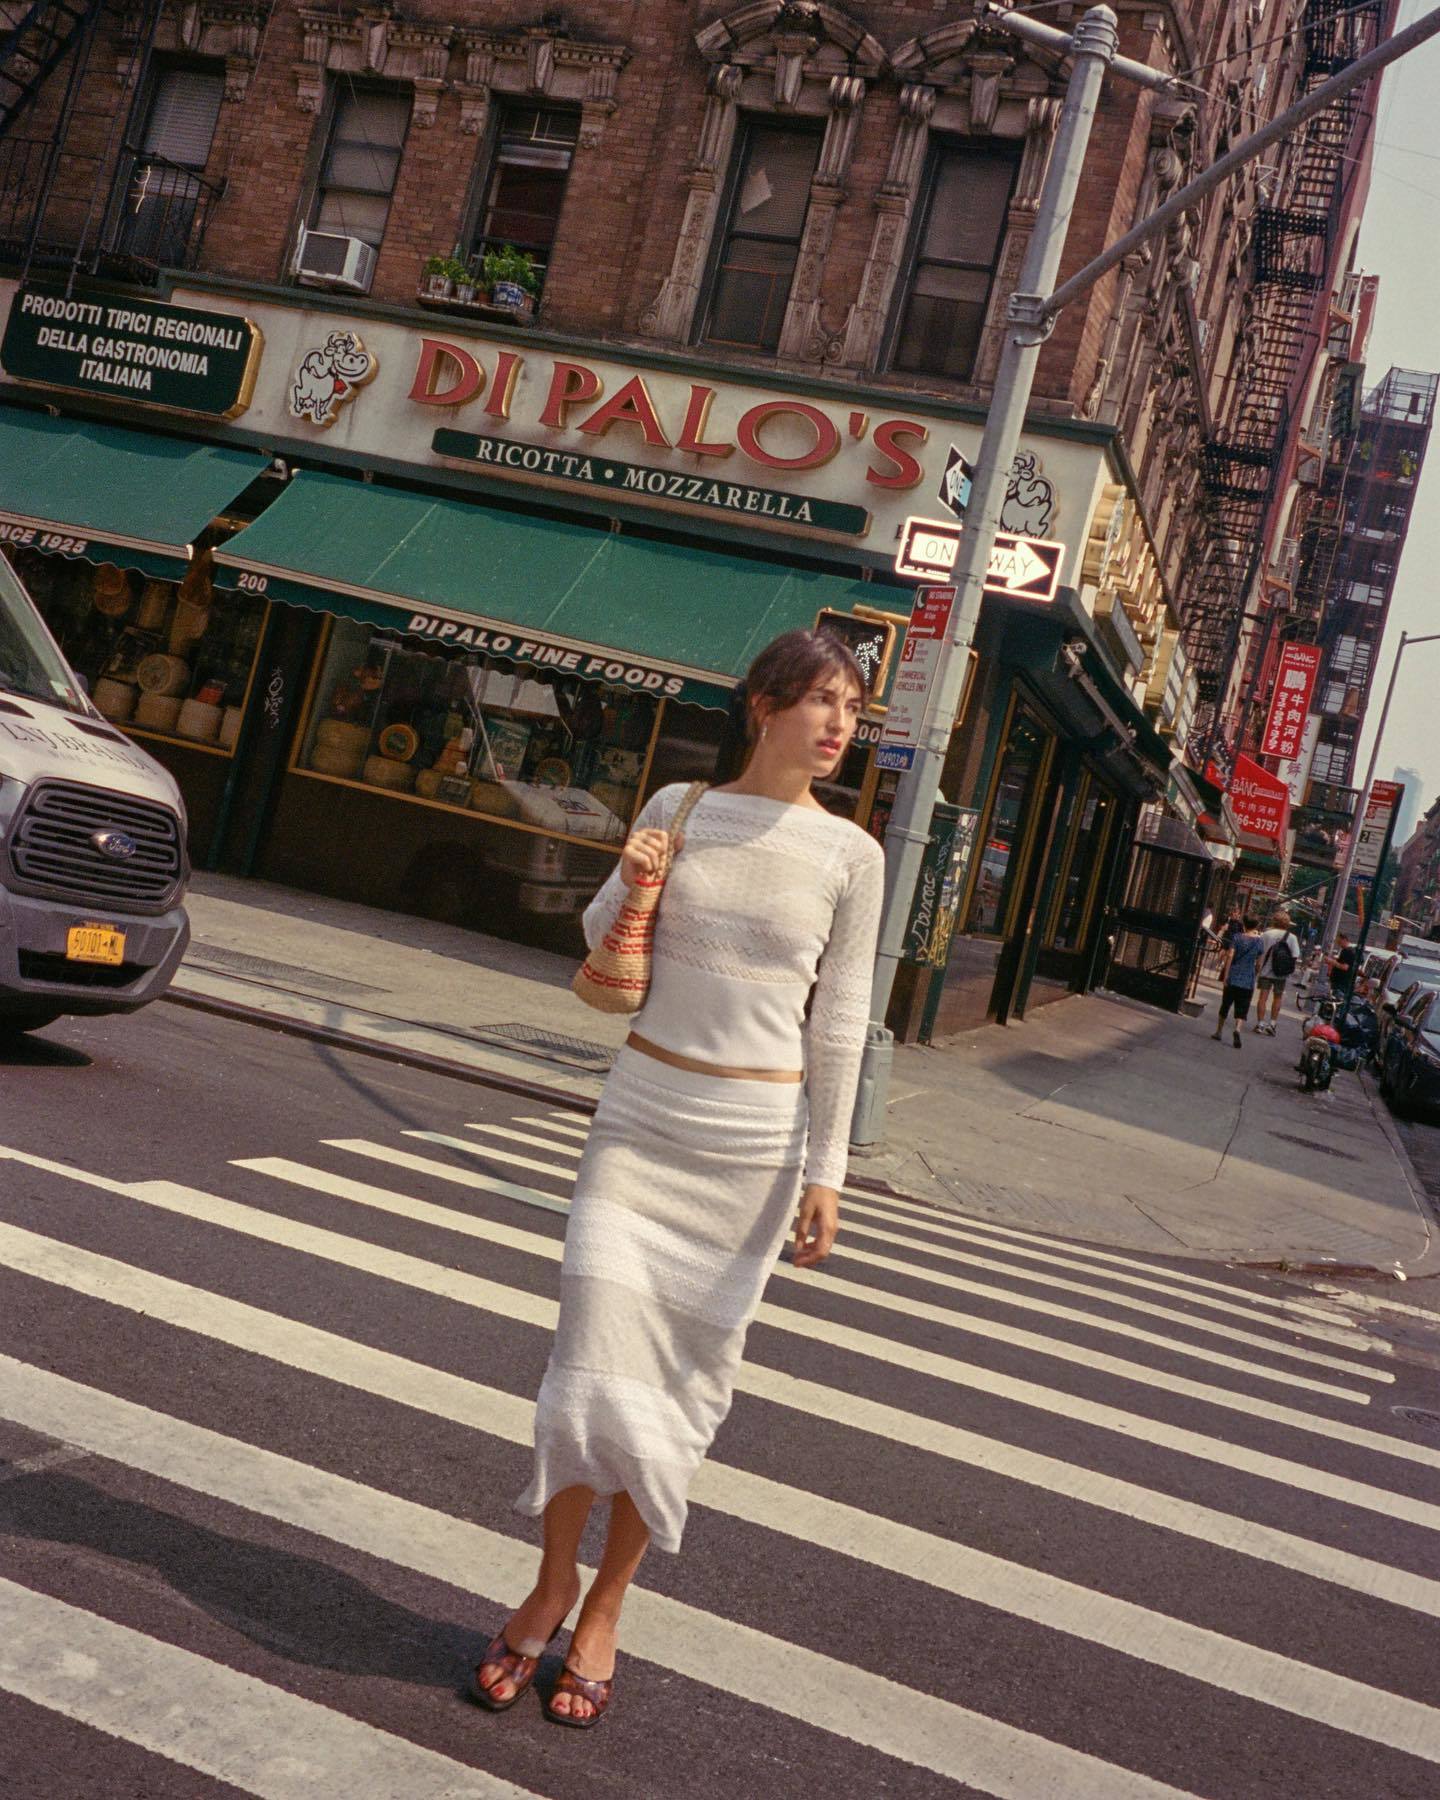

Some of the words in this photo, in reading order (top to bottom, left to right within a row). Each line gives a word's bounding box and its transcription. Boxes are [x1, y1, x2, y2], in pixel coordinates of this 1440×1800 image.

[21, 294, 102, 326] PRODOTTI
[106, 307, 150, 335] TIPICI
[152, 316, 243, 351] REGIONALI
[37, 327, 88, 354] DELLA
[92, 337, 208, 376] GASTRONOMIA
[79, 359, 152, 391] ITALIANA
[408, 338, 521, 419] DI
[539, 360, 929, 490] PALO'S
[476, 439, 594, 481] RICOTTA
[622, 467, 814, 523] MOZZARELLA
[40, 532, 87, 554] 1925
[924, 539, 956, 561] ON
[989, 552, 1034, 577] WAY
[238, 572, 268, 593] 200
[408, 615, 512, 652] DIPALO
[515, 641, 583, 674] FINE
[585, 658, 686, 695] FOODS
[904, 640, 914, 660] 3
[853, 724, 881, 743] 00
[1236, 814, 1279, 832] 66-3797
